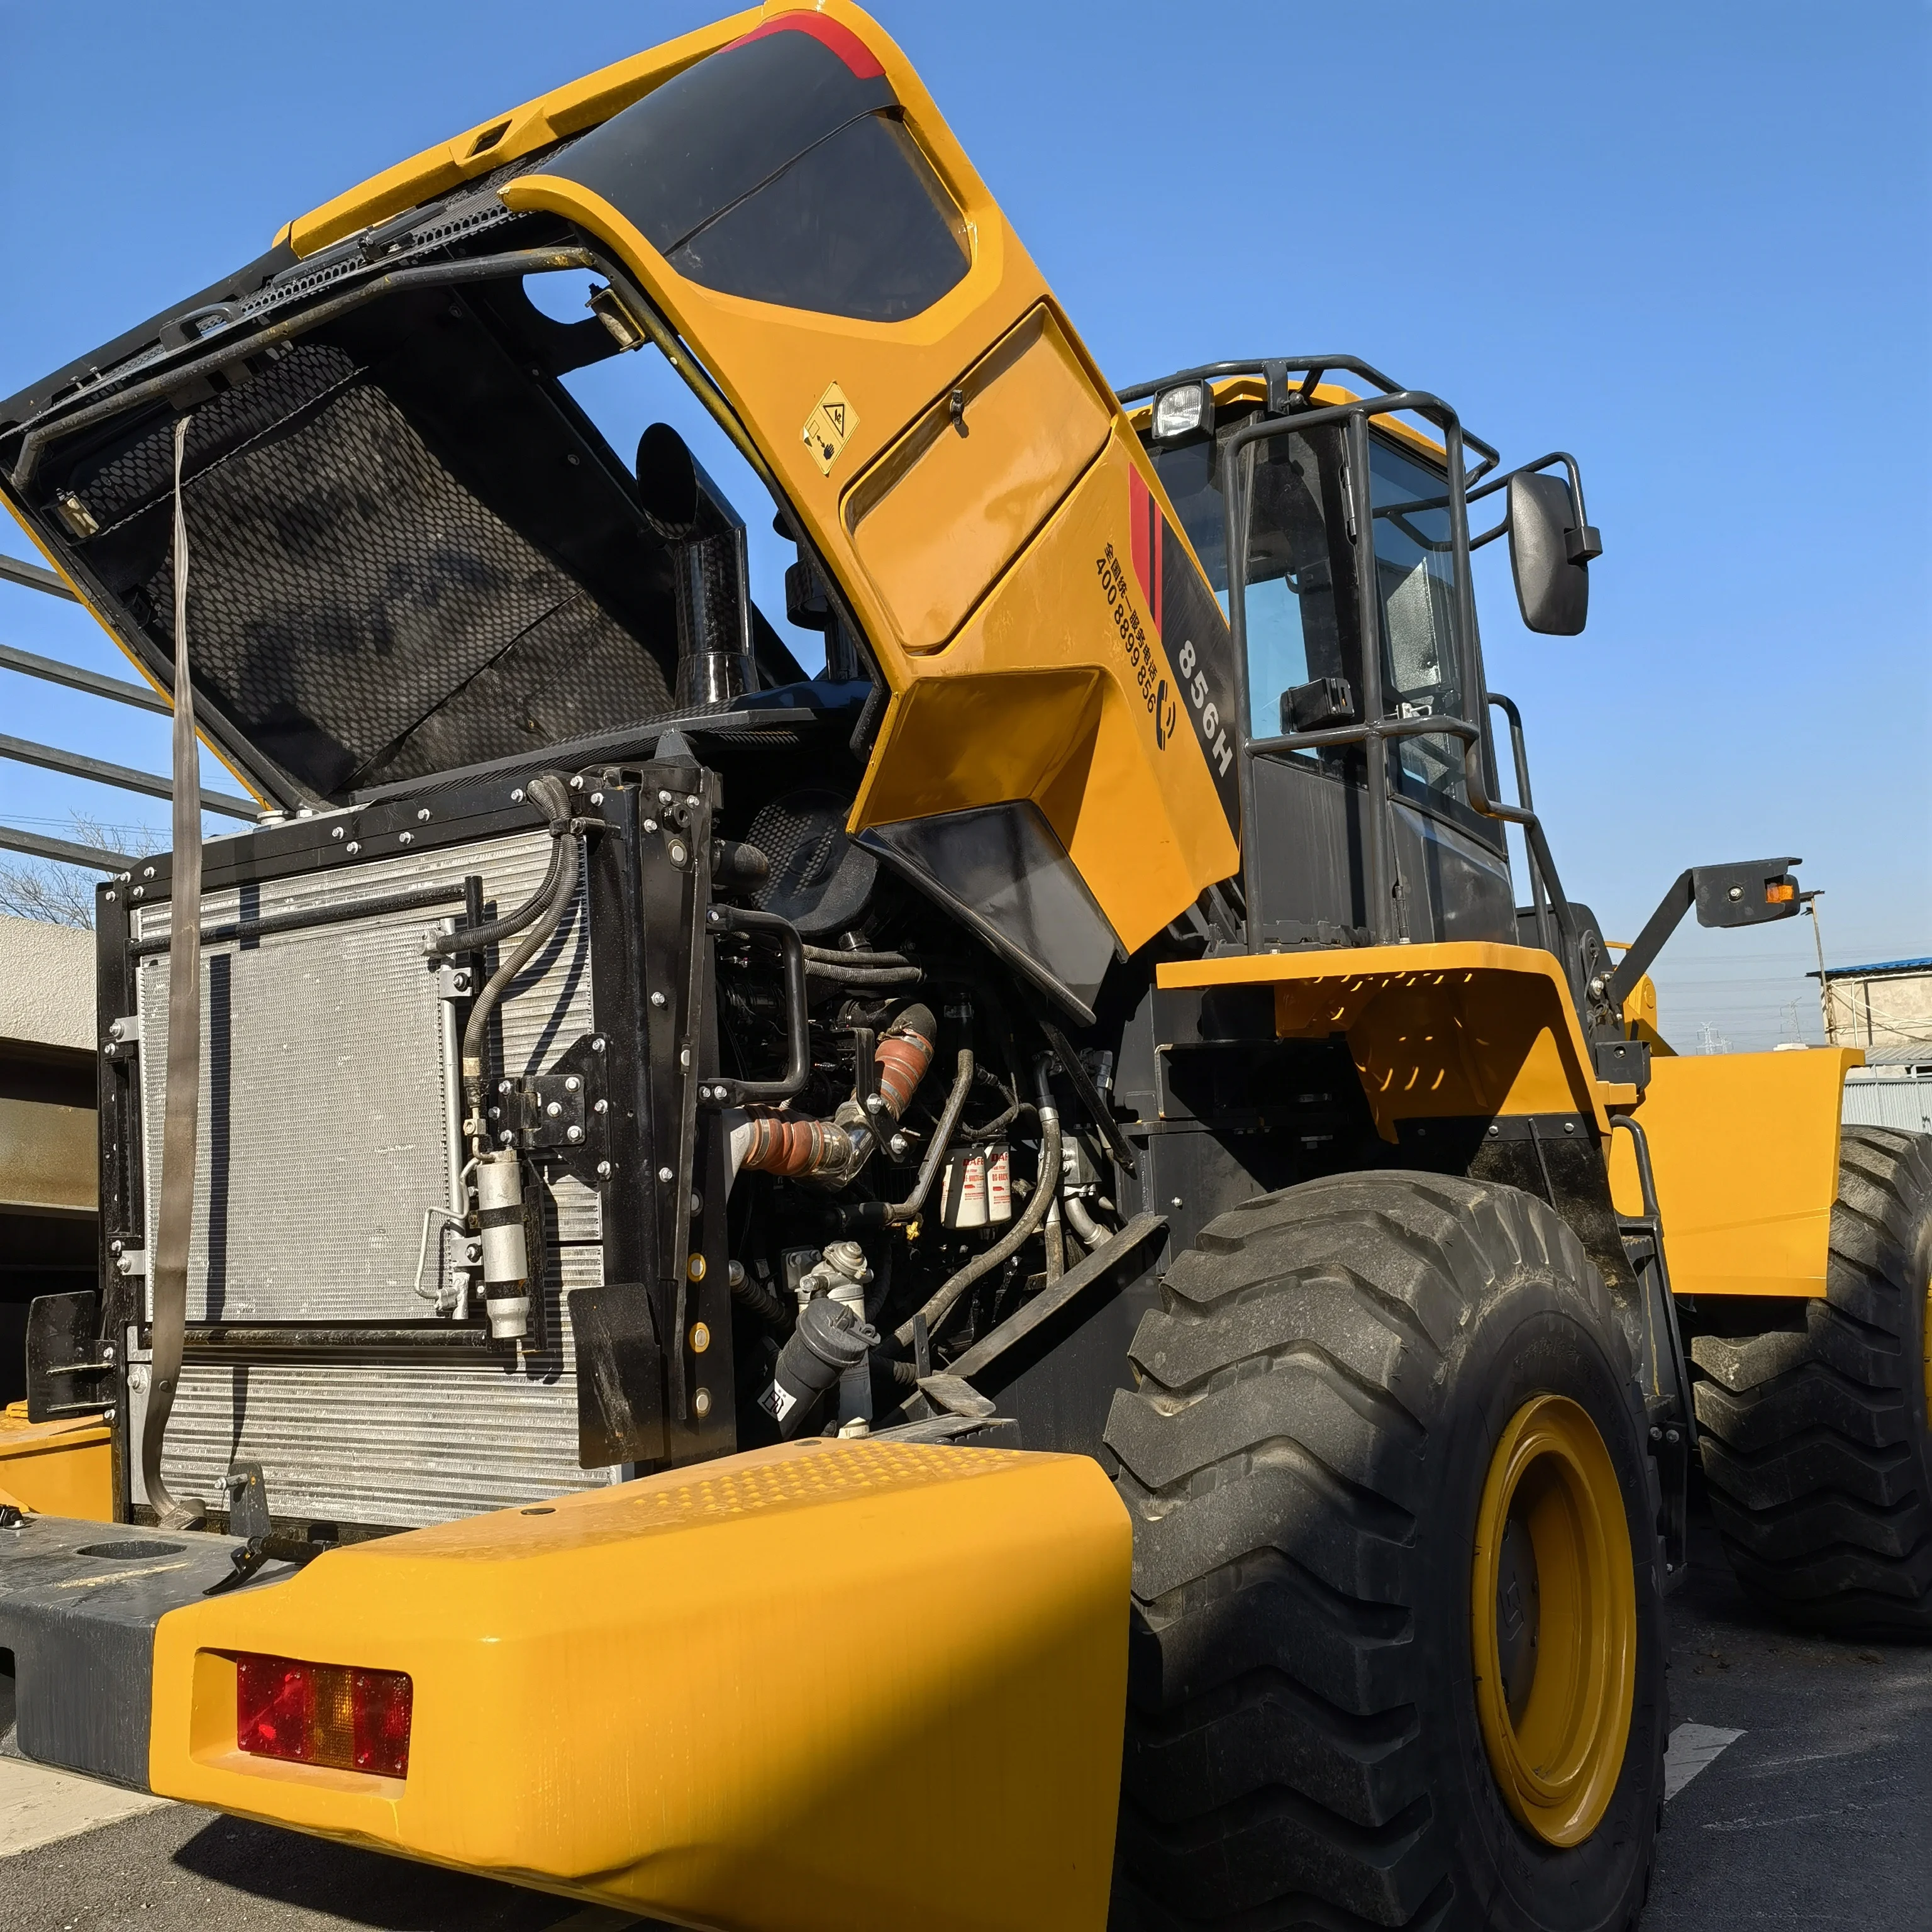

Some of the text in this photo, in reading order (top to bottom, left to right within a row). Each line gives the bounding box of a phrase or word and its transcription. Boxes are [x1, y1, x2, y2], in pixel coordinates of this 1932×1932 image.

[1096, 558, 1157, 714] 400 8899 856
[1104, 542, 1158, 683] 全国统一服务电话
[1179, 640, 1233, 777] 856H
